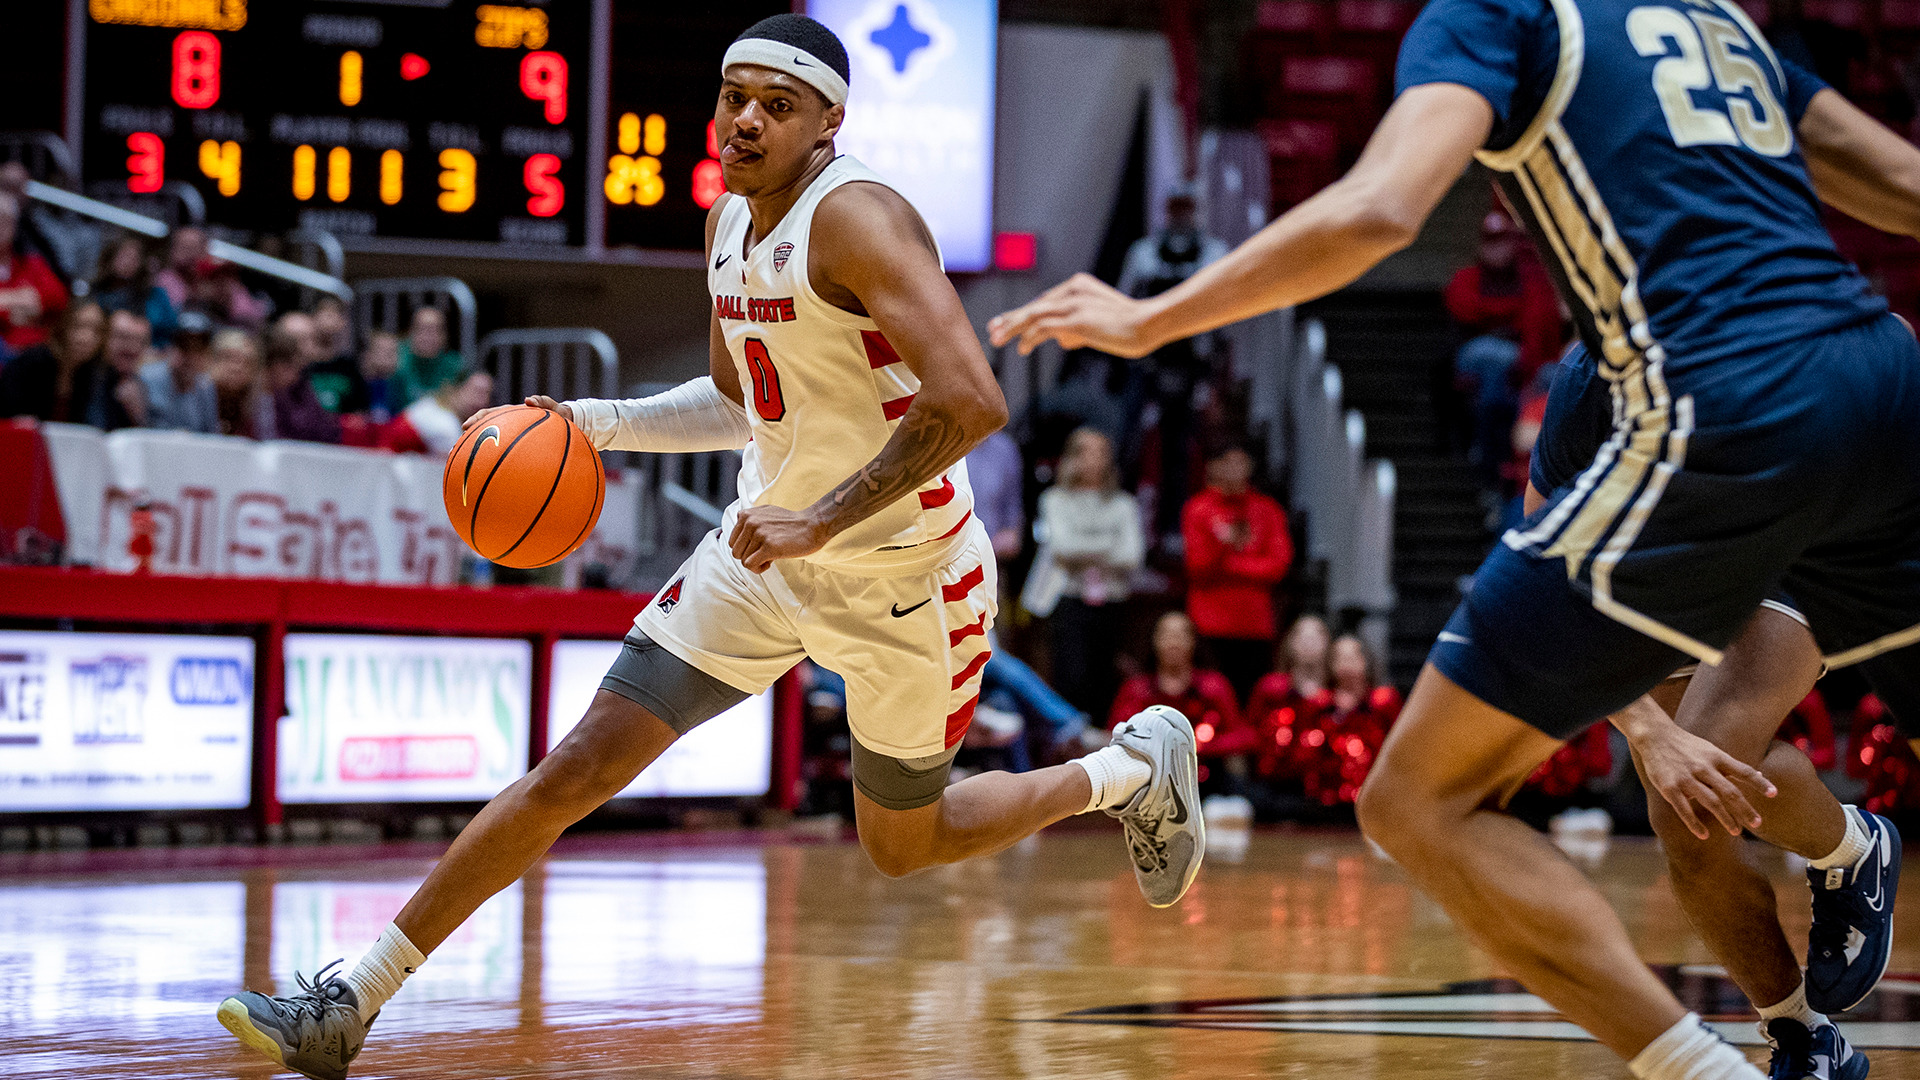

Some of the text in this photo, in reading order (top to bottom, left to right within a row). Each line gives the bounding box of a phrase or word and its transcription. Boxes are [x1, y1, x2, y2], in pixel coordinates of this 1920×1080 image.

[171, 30, 222, 109] 8
[339, 51, 363, 106] 1
[520, 51, 568, 125] 9
[1625, 6, 1794, 158] 25
[126, 132, 165, 193] 3
[618, 111, 666, 156] 11
[198, 139, 242, 197] 4
[437, 148, 477, 213] 3
[523, 153, 565, 217] 5
[716, 294, 797, 322] BALL STATE
[744, 337, 786, 422] 0
